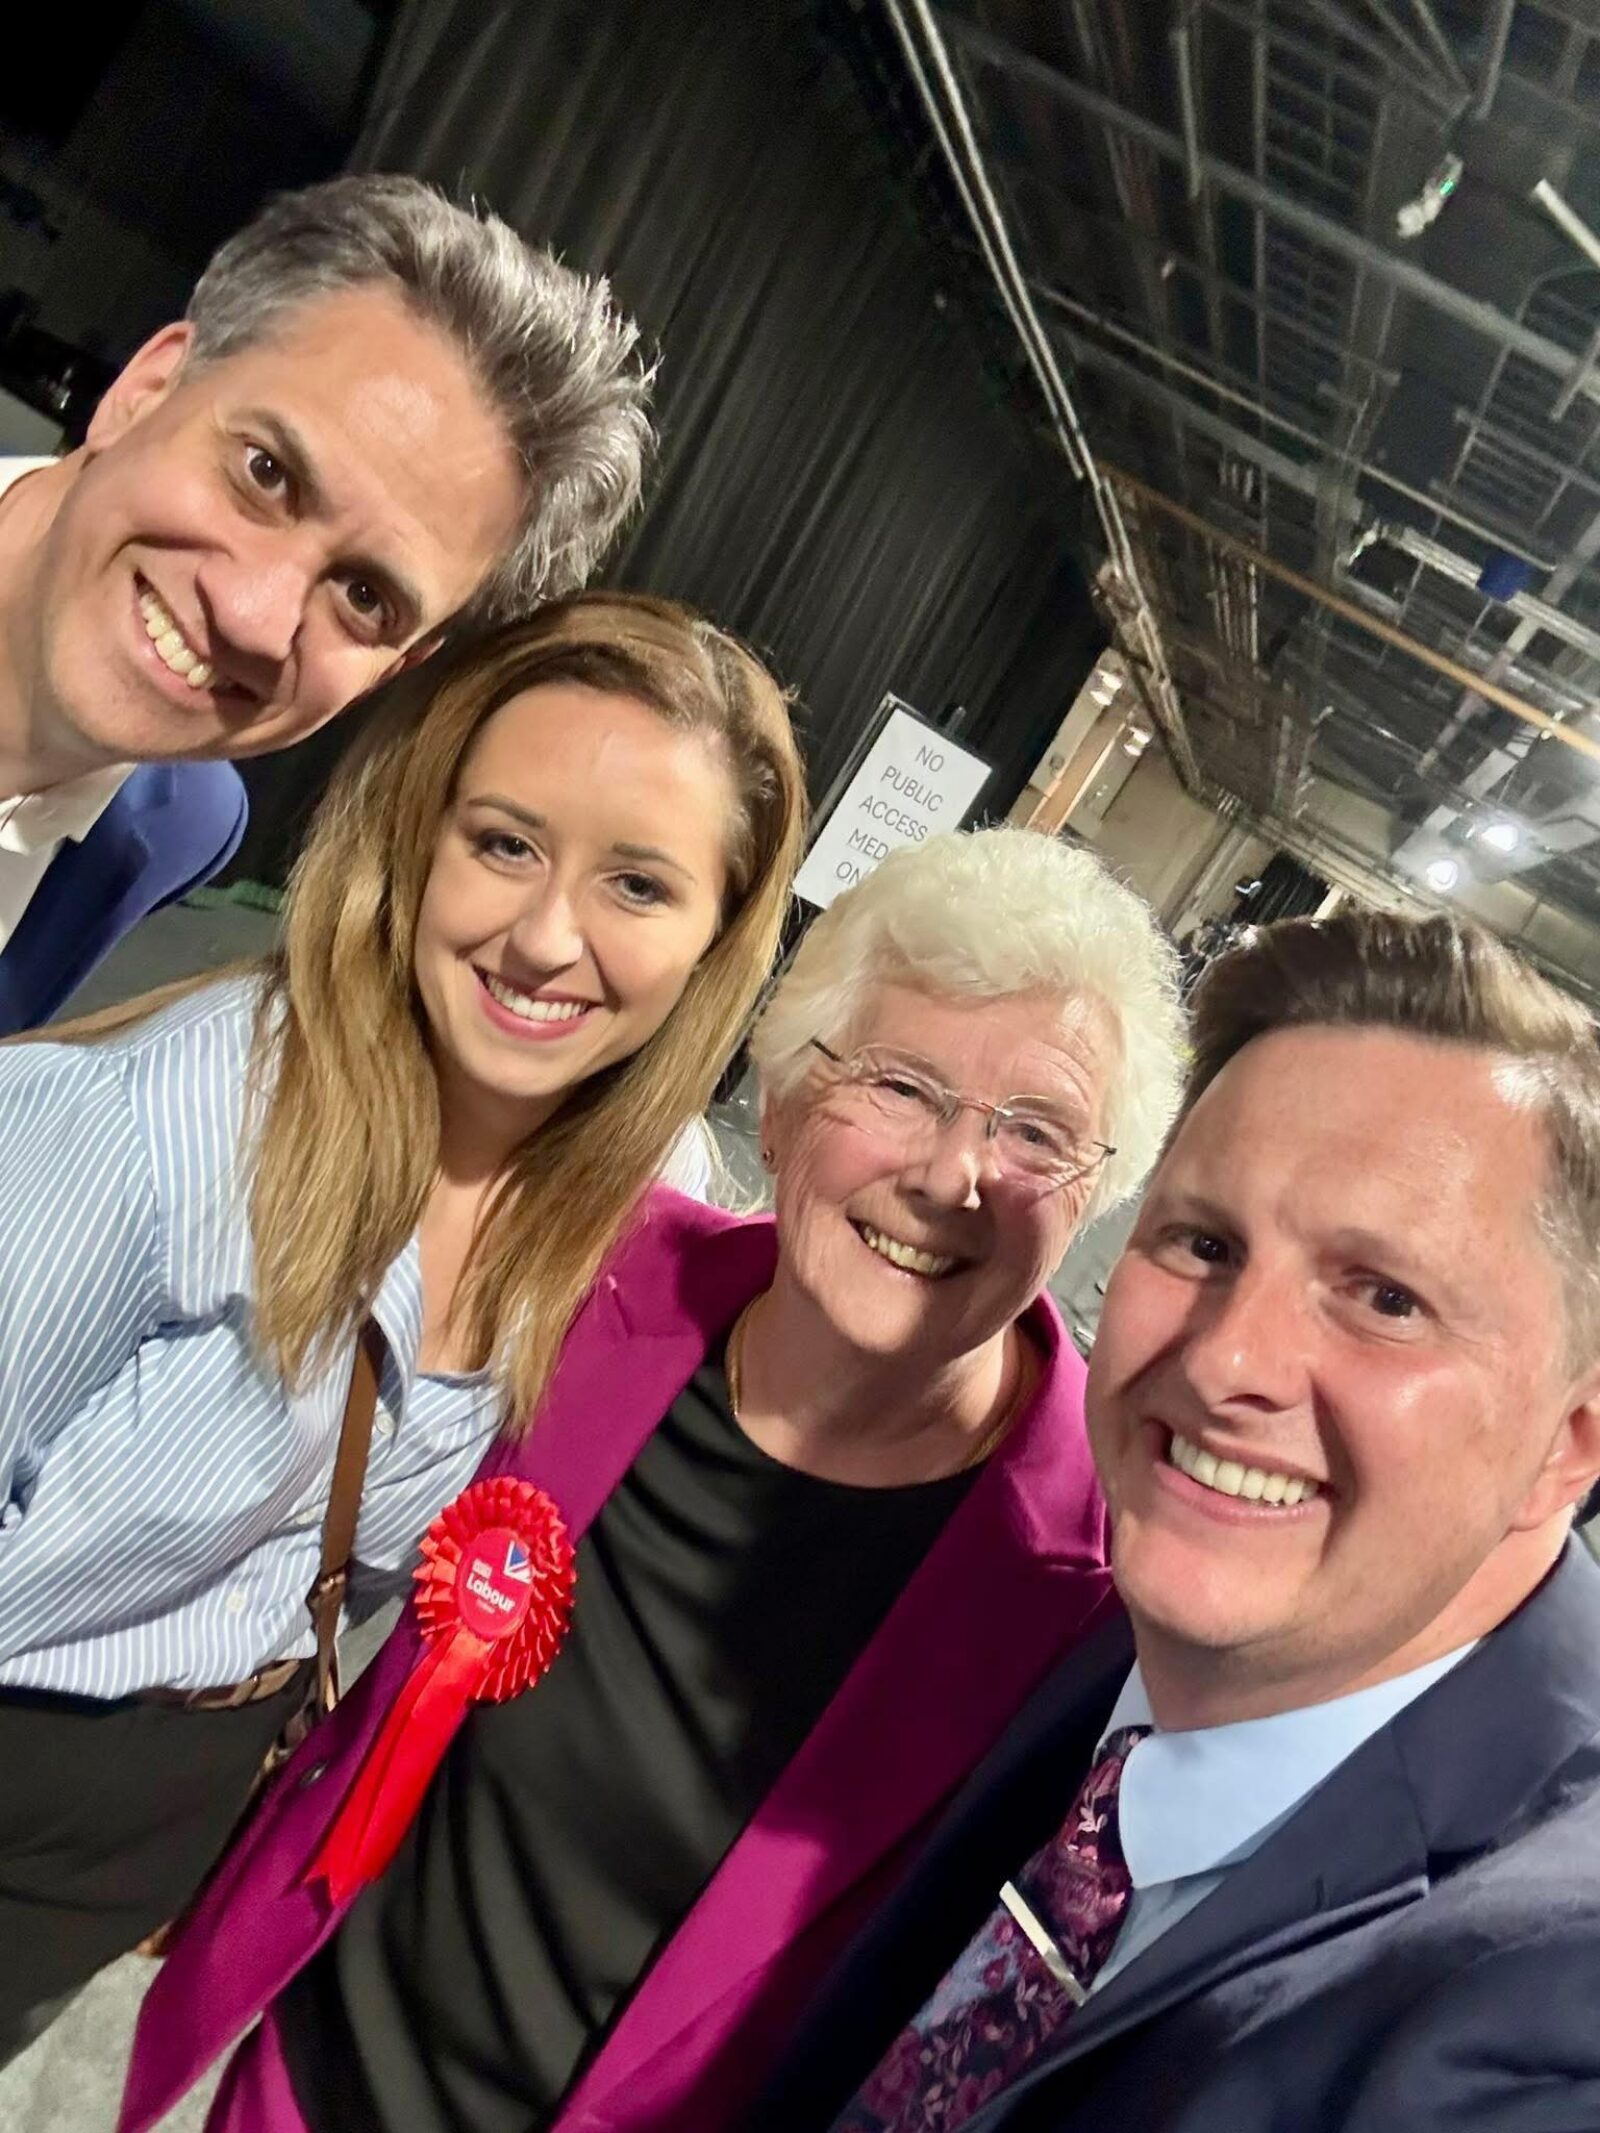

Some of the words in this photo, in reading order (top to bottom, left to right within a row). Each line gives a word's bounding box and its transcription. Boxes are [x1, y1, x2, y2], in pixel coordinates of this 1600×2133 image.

[915, 745, 944, 772] NO
[880, 765, 943, 812] PUBLIC
[858, 795, 928, 842] ACCESS
[847, 828, 889, 860] MED
[836, 861, 860, 885] ON
[466, 1572, 516, 1613] Labour
